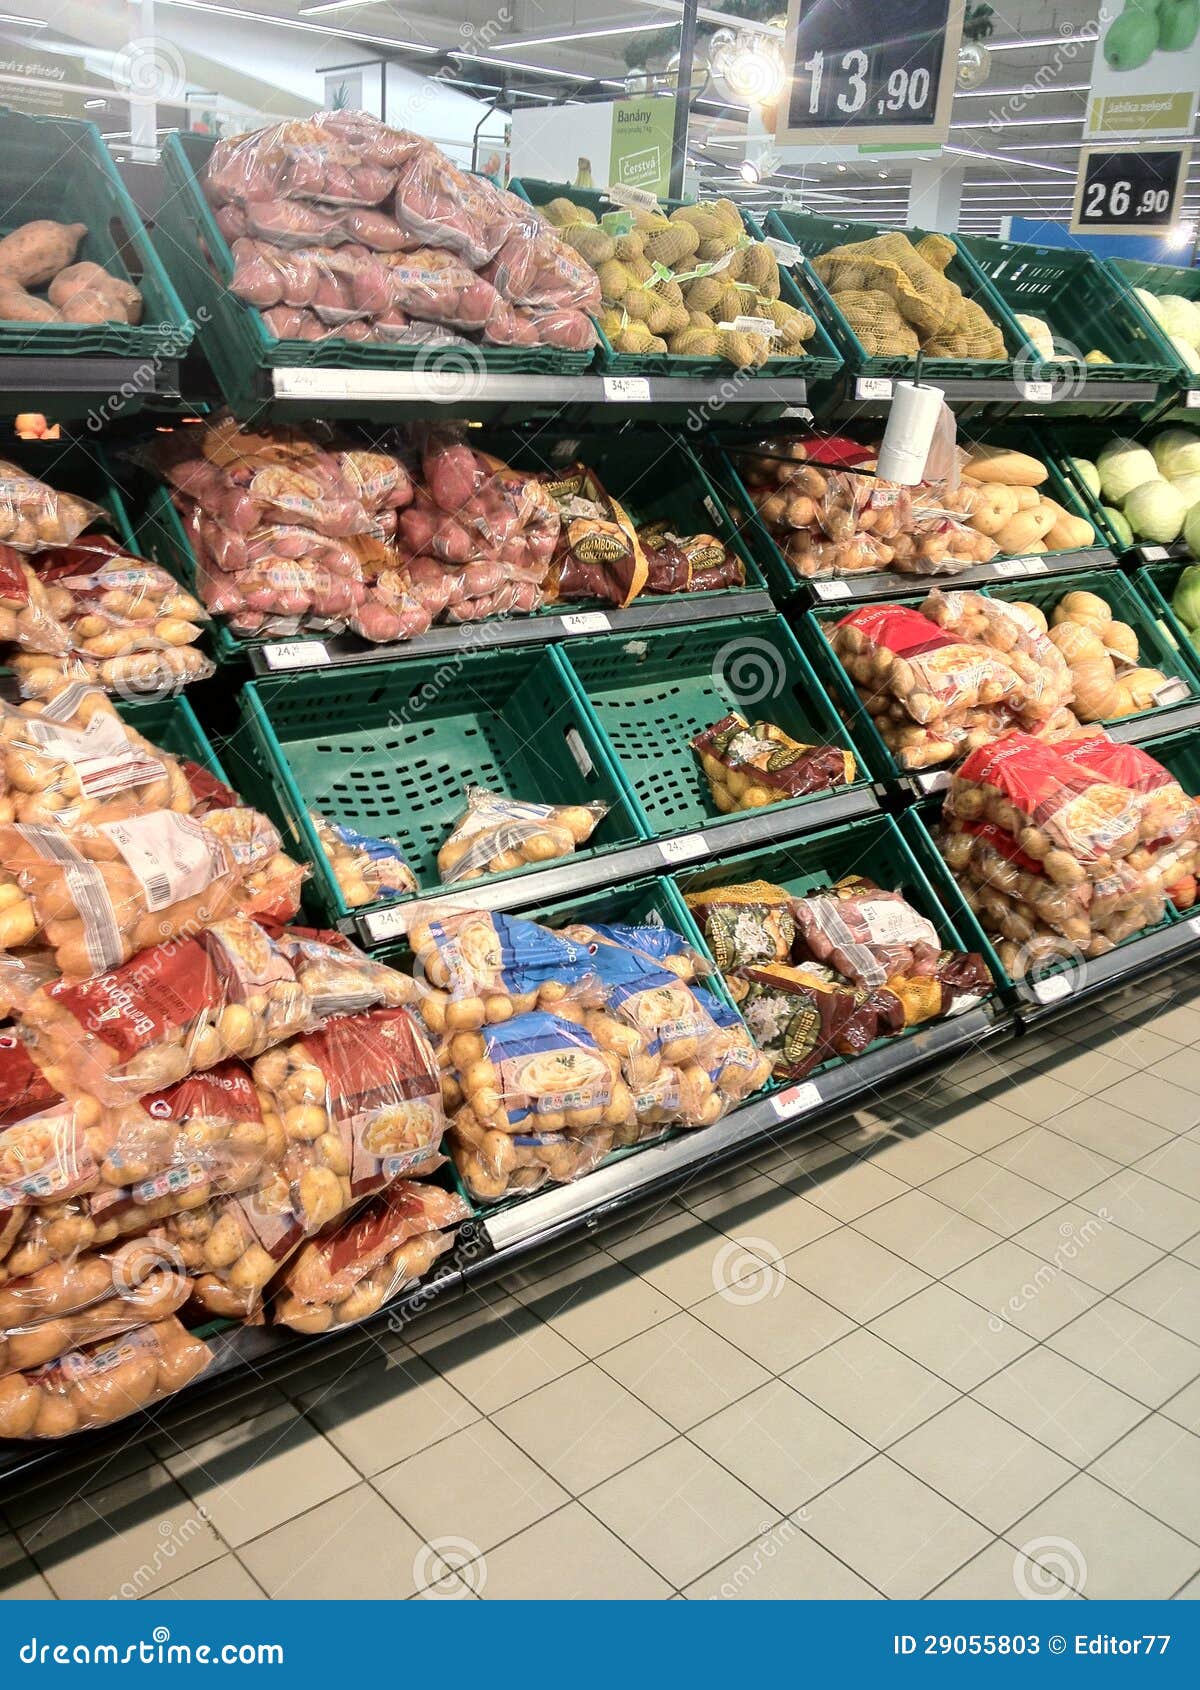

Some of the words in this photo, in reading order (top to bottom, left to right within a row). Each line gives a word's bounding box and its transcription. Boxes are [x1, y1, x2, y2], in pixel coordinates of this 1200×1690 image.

[617, 108, 652, 123] Banány
[580, 537, 622, 551] BRAMBORY
[981, 743, 1031, 778] Brambory
[1061, 738, 1105, 763] Brambo
[97, 974, 156, 1037] Brambory
